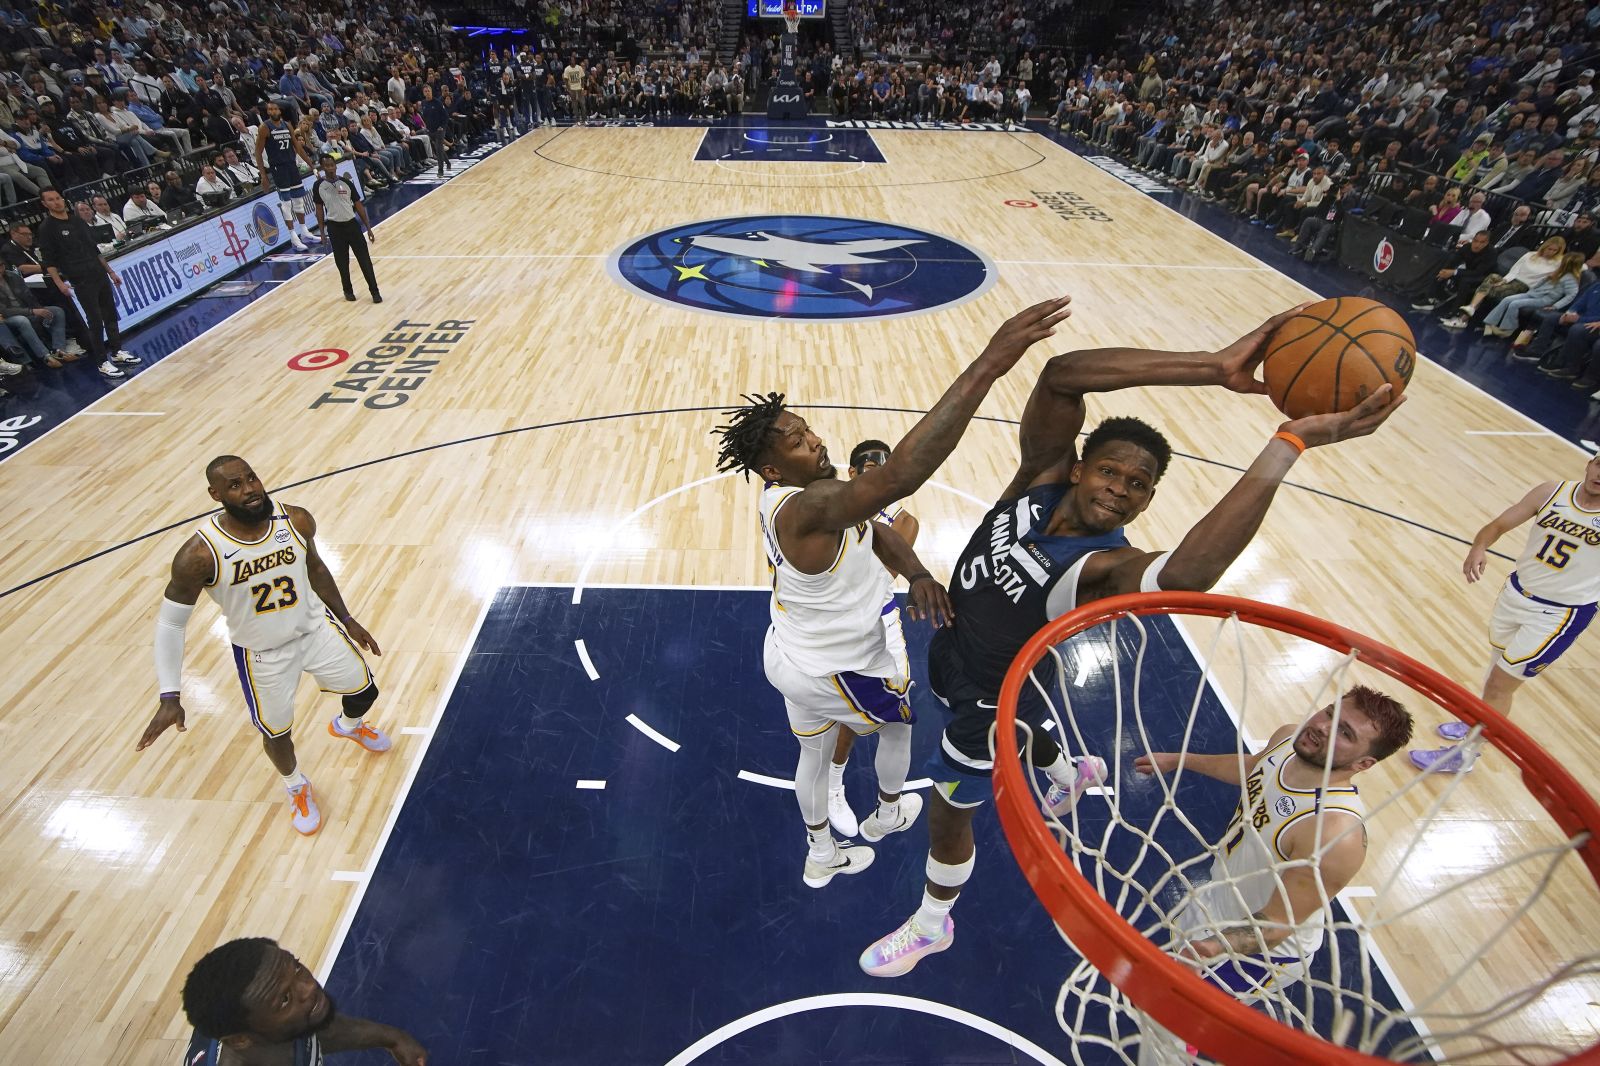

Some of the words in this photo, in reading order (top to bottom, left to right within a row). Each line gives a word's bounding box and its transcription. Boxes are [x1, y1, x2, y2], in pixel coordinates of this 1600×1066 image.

[797, 4, 818, 13] LTRA
[773, 95, 800, 103] KIA
[826, 120, 1034, 132] MINNESOTA
[278, 139, 290, 150] 27
[1030, 190, 1084, 221] TARGET
[1055, 191, 1113, 222] CENTER
[183, 252, 218, 279] Google
[307, 319, 431, 409] TARGET
[363, 319, 476, 409] CENTER
[1536, 510, 1600, 546] LAKERS
[230, 546, 297, 586] LAKERS
[1031, 547, 1051, 568] sezzle
[1535, 534, 1579, 571] 15
[960, 555, 989, 590] 5
[251, 575, 298, 615] 23
[1246, 767, 1271, 833] LAKRS
